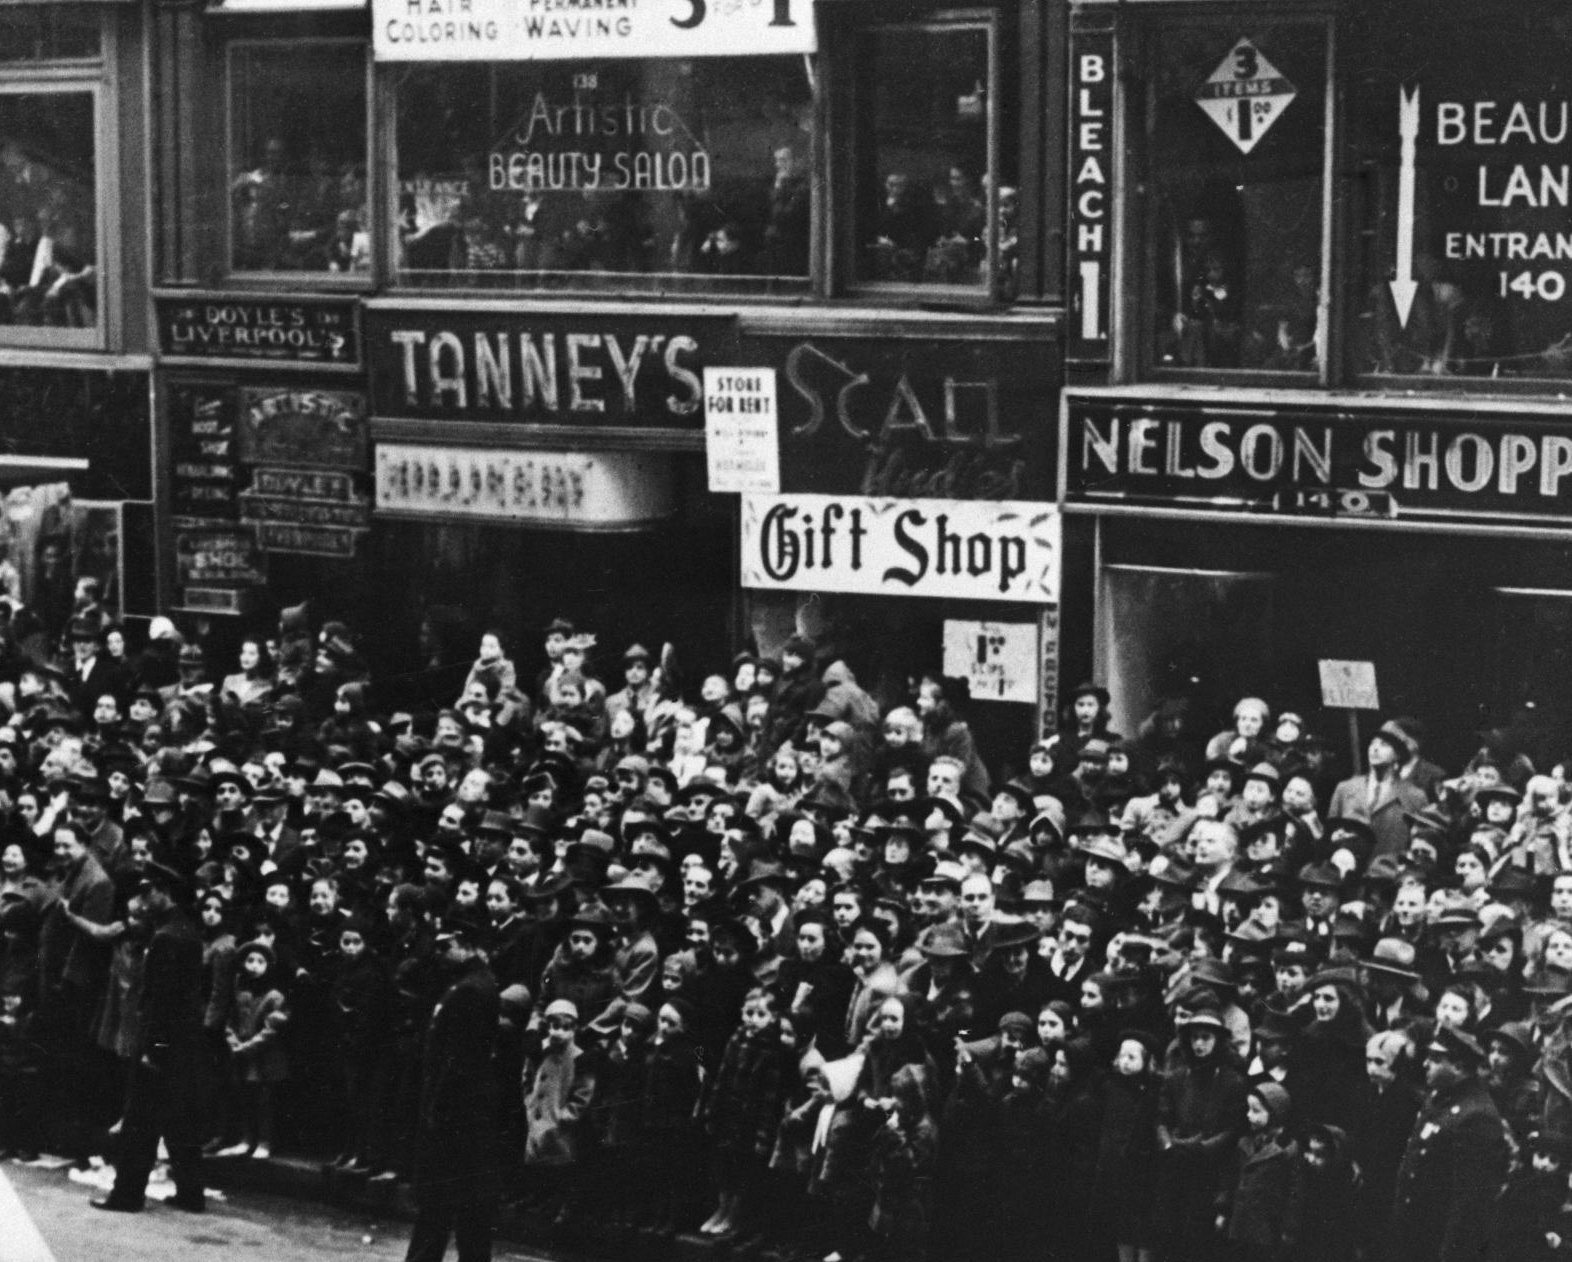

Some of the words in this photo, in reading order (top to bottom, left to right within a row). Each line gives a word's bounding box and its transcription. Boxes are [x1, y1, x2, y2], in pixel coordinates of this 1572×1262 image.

[386, 19, 498, 43] COLORING
[525, 16, 632, 39] WAVING
[1233, 45, 1259, 79] 3
[1214, 81, 1272, 97] ITEMS
[1437, 101, 1567, 145] BEAU
[489, 152, 601, 190] BEAUTY
[1077, 55, 1105, 252] BLEACH
[1479, 164, 1569, 207] LAN
[1500, 270, 1566, 301] 140
[391, 328, 703, 414] TANNEY'S
[717, 376, 760, 392] STORE
[709, 396, 733, 413] FOR
[739, 397, 769, 413] RENT
[1081, 416, 1333, 483] NELSON
[760, 503, 868, 581] Gift
[882, 508, 1027, 592] Shop
